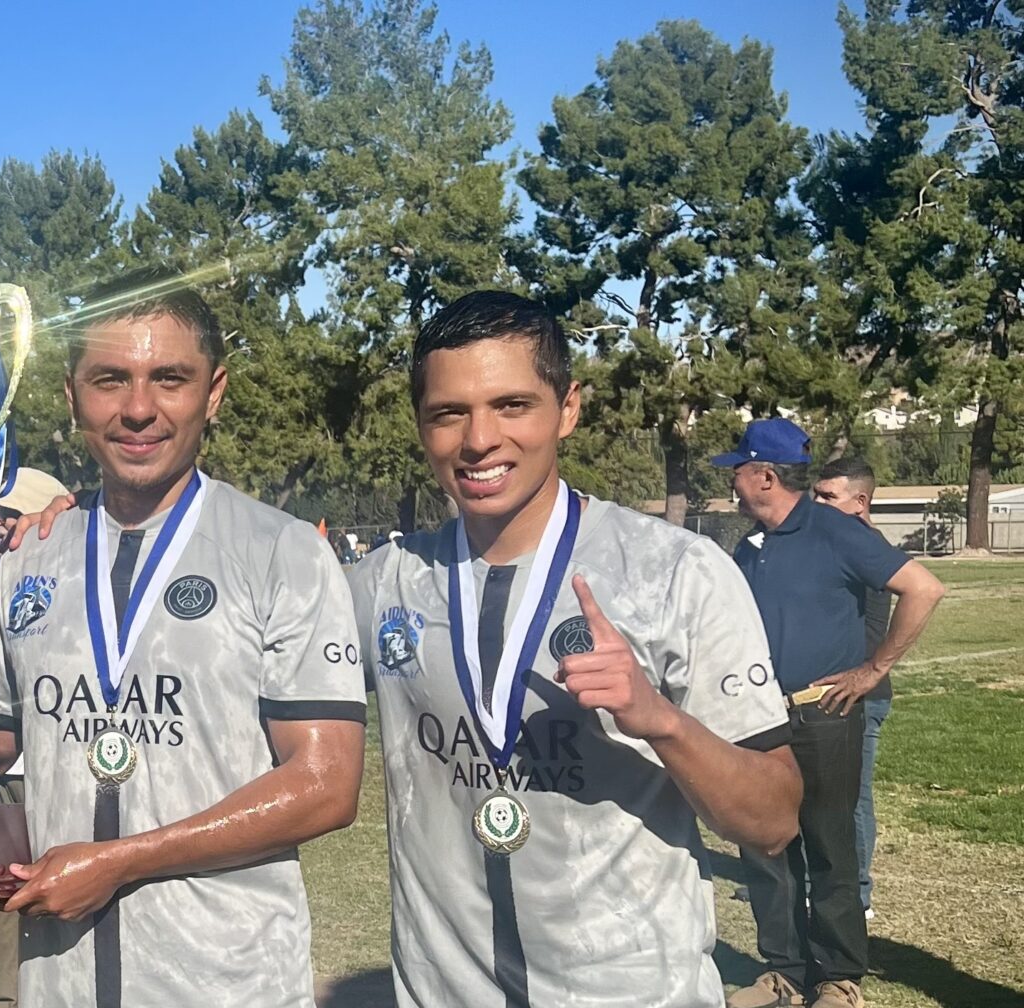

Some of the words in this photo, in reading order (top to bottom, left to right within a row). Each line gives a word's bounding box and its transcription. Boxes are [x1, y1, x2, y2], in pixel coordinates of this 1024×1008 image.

[179, 581, 207, 591] PARIS
[564, 621, 587, 632] PAR
[33, 674, 184, 724] QAAR
[417, 712, 583, 765] QAAR
[452, 761, 585, 792] AIRWAYS
